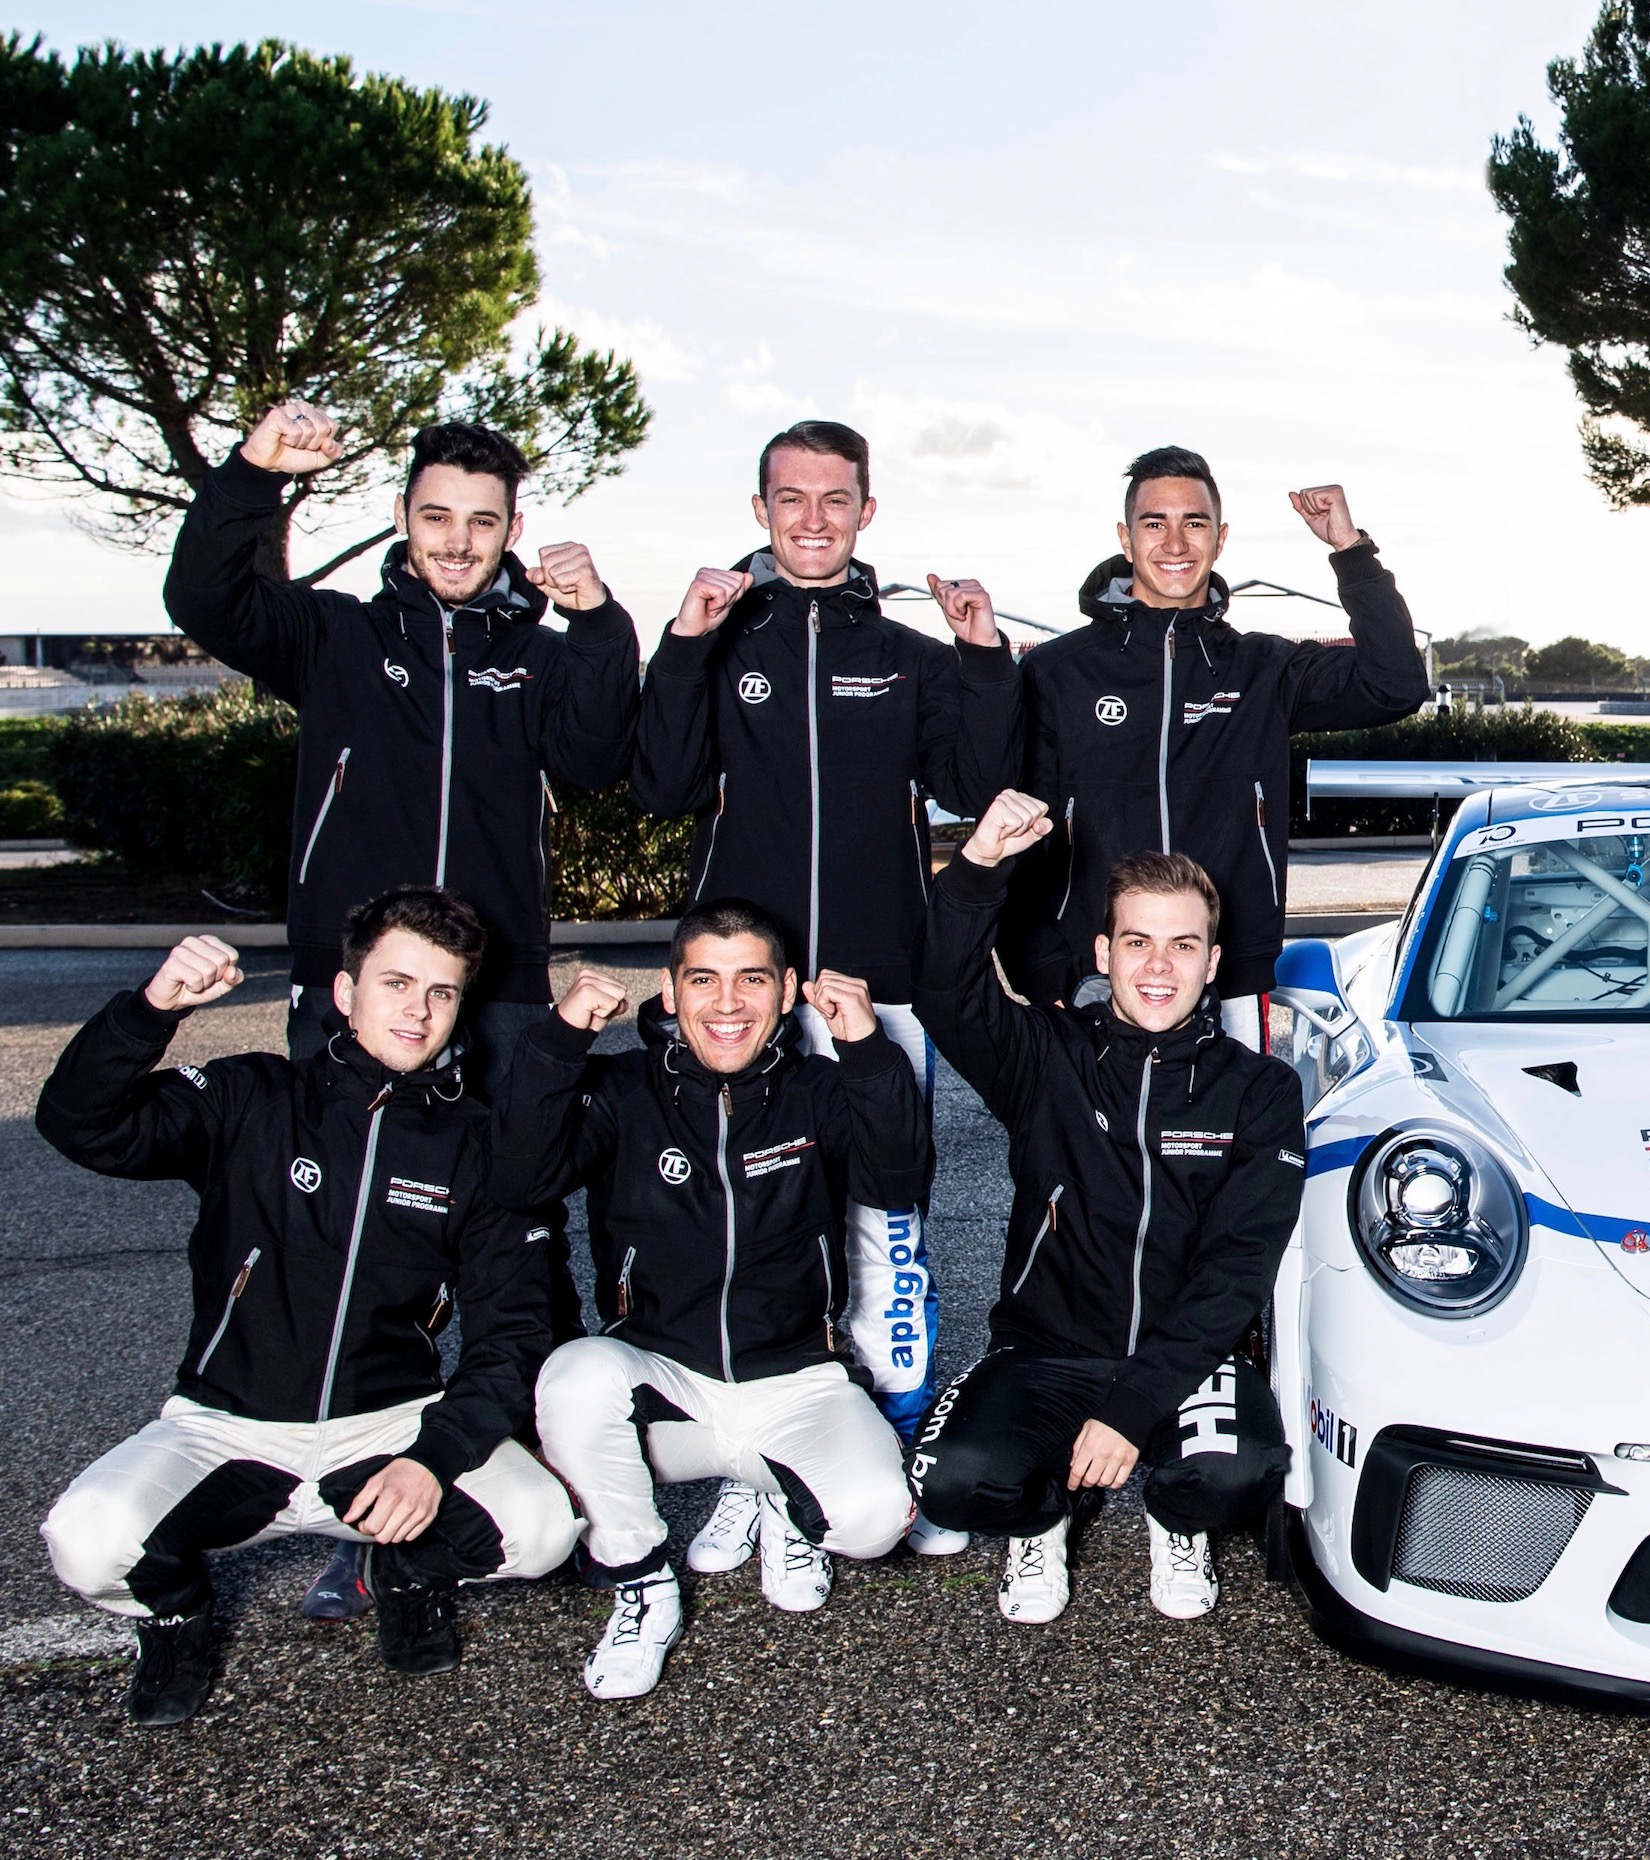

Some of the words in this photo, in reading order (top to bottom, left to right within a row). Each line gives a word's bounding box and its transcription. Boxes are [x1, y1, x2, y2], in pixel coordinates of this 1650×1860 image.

[740, 676, 770, 699] ZF
[1096, 700, 1126, 722] ZF
[1479, 825, 1517, 846] 70
[1161, 1131, 1234, 1140] PORSCHE
[743, 1136, 807, 1161] PORSCHE
[1161, 1142, 1203, 1150] MOTORSPORT
[1161, 1148, 1184, 1156] JUNIOR
[1184, 1149, 1223, 1157] PROGRAMME
[660, 1152, 690, 1180] ZF
[744, 1156, 781, 1172] MOTORSPORT
[746, 1166, 768, 1178] JUNIOR
[291, 1162, 319, 1189] ZF
[386, 1196, 411, 1207] JUNIOR
[388, 1189, 433, 1204] MOTORSPORT
